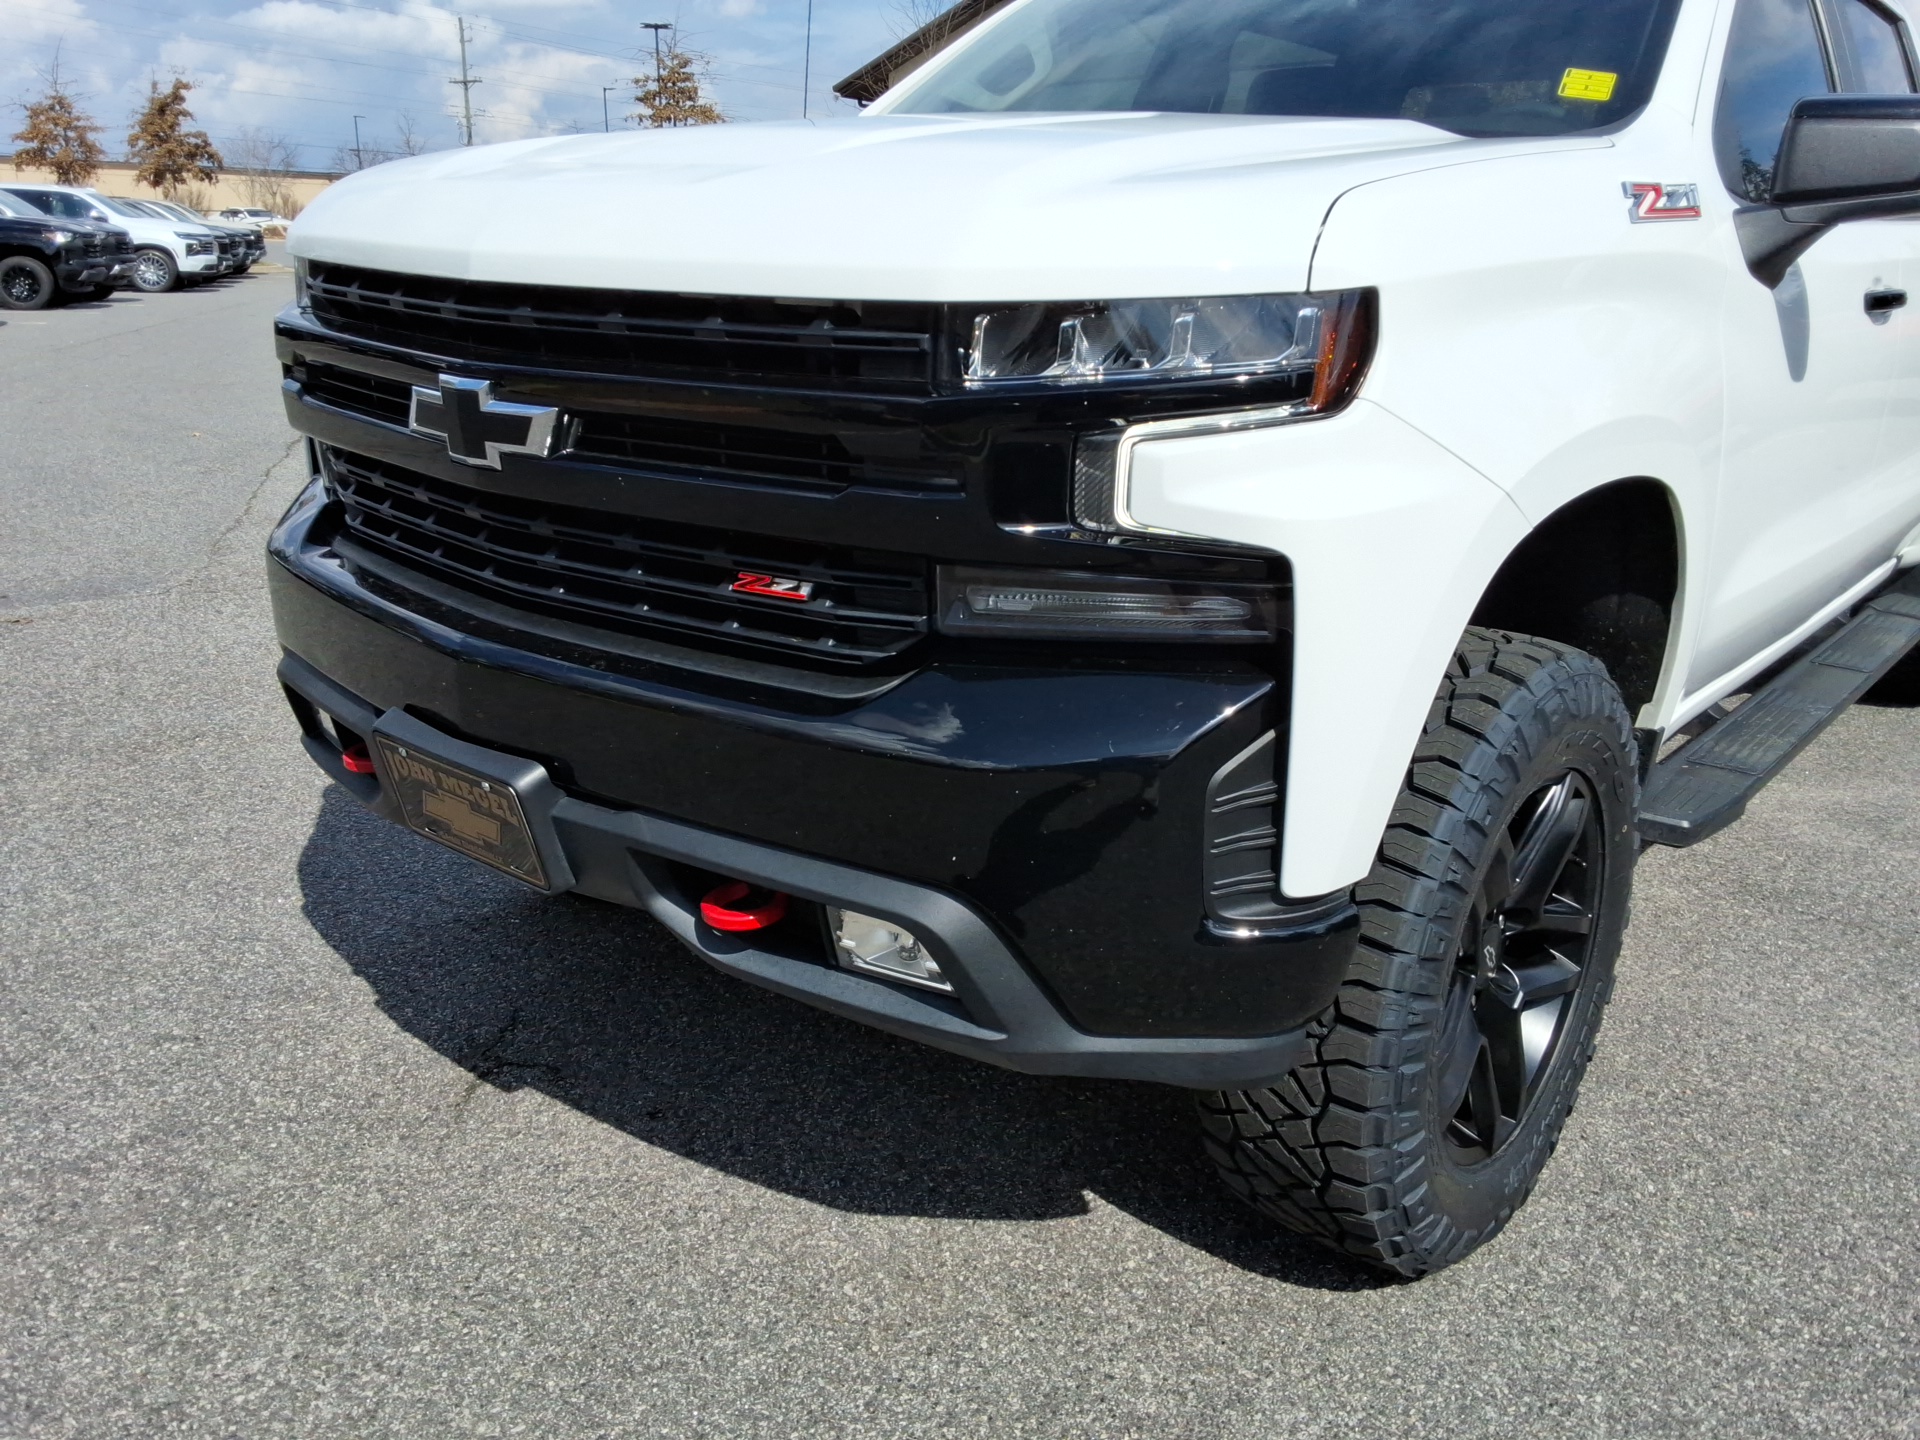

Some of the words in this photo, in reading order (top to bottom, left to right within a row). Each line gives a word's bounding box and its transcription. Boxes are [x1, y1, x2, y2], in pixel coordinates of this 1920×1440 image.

[1621, 181, 1702, 224] Z71
[732, 572, 814, 600] Z71
[383, 748, 437, 785] JOHN
[438, 771, 519, 826] MEGEL
